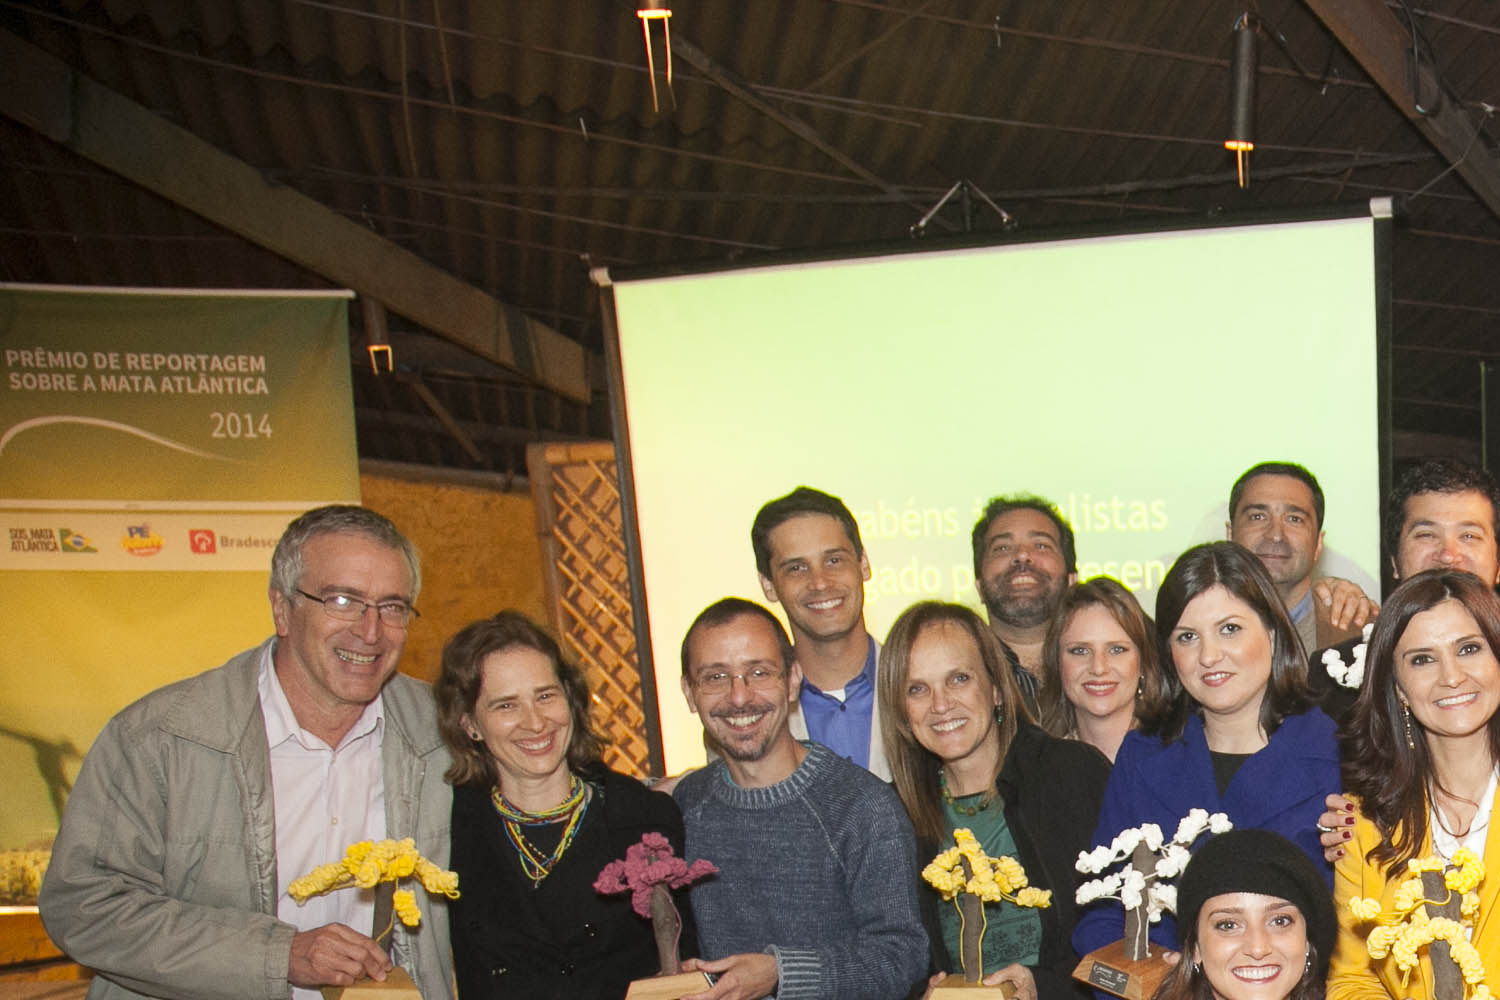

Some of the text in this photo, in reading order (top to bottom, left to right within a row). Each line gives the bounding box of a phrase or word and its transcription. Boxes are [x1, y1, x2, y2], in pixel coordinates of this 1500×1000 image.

[5, 347, 266, 372] PRÊMIO DE REPORTAGEM
[9, 373, 269, 394] SOBRE A MATA ATLÂNTICA
[210, 412, 272, 438] 2014
[857, 495, 960, 537] abéns
